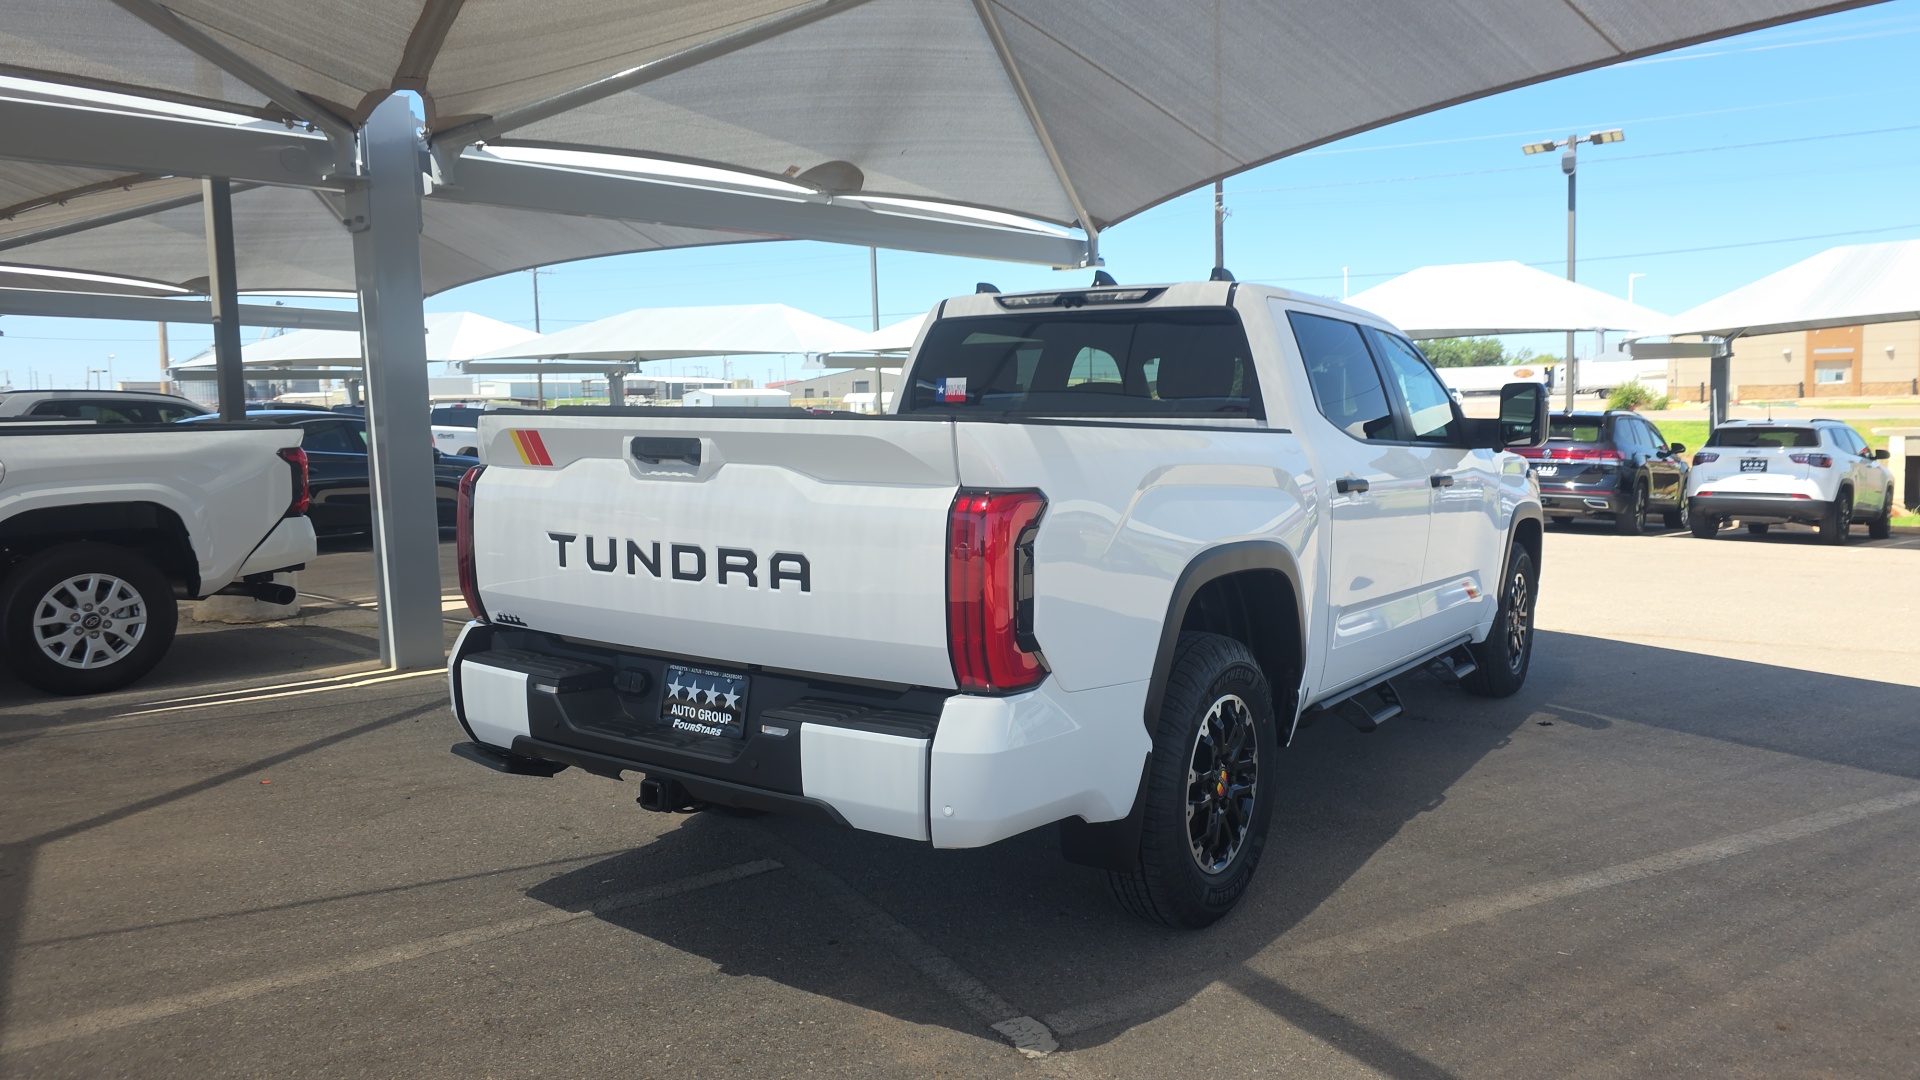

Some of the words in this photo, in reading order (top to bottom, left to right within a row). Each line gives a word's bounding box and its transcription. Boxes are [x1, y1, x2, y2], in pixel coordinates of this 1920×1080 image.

[546, 532, 811, 593] TUNDRA
[1214, 668, 1254, 695] MICHELIN
[670, 703, 696, 718] AUTO
[698, 708, 733, 725] GROUP
